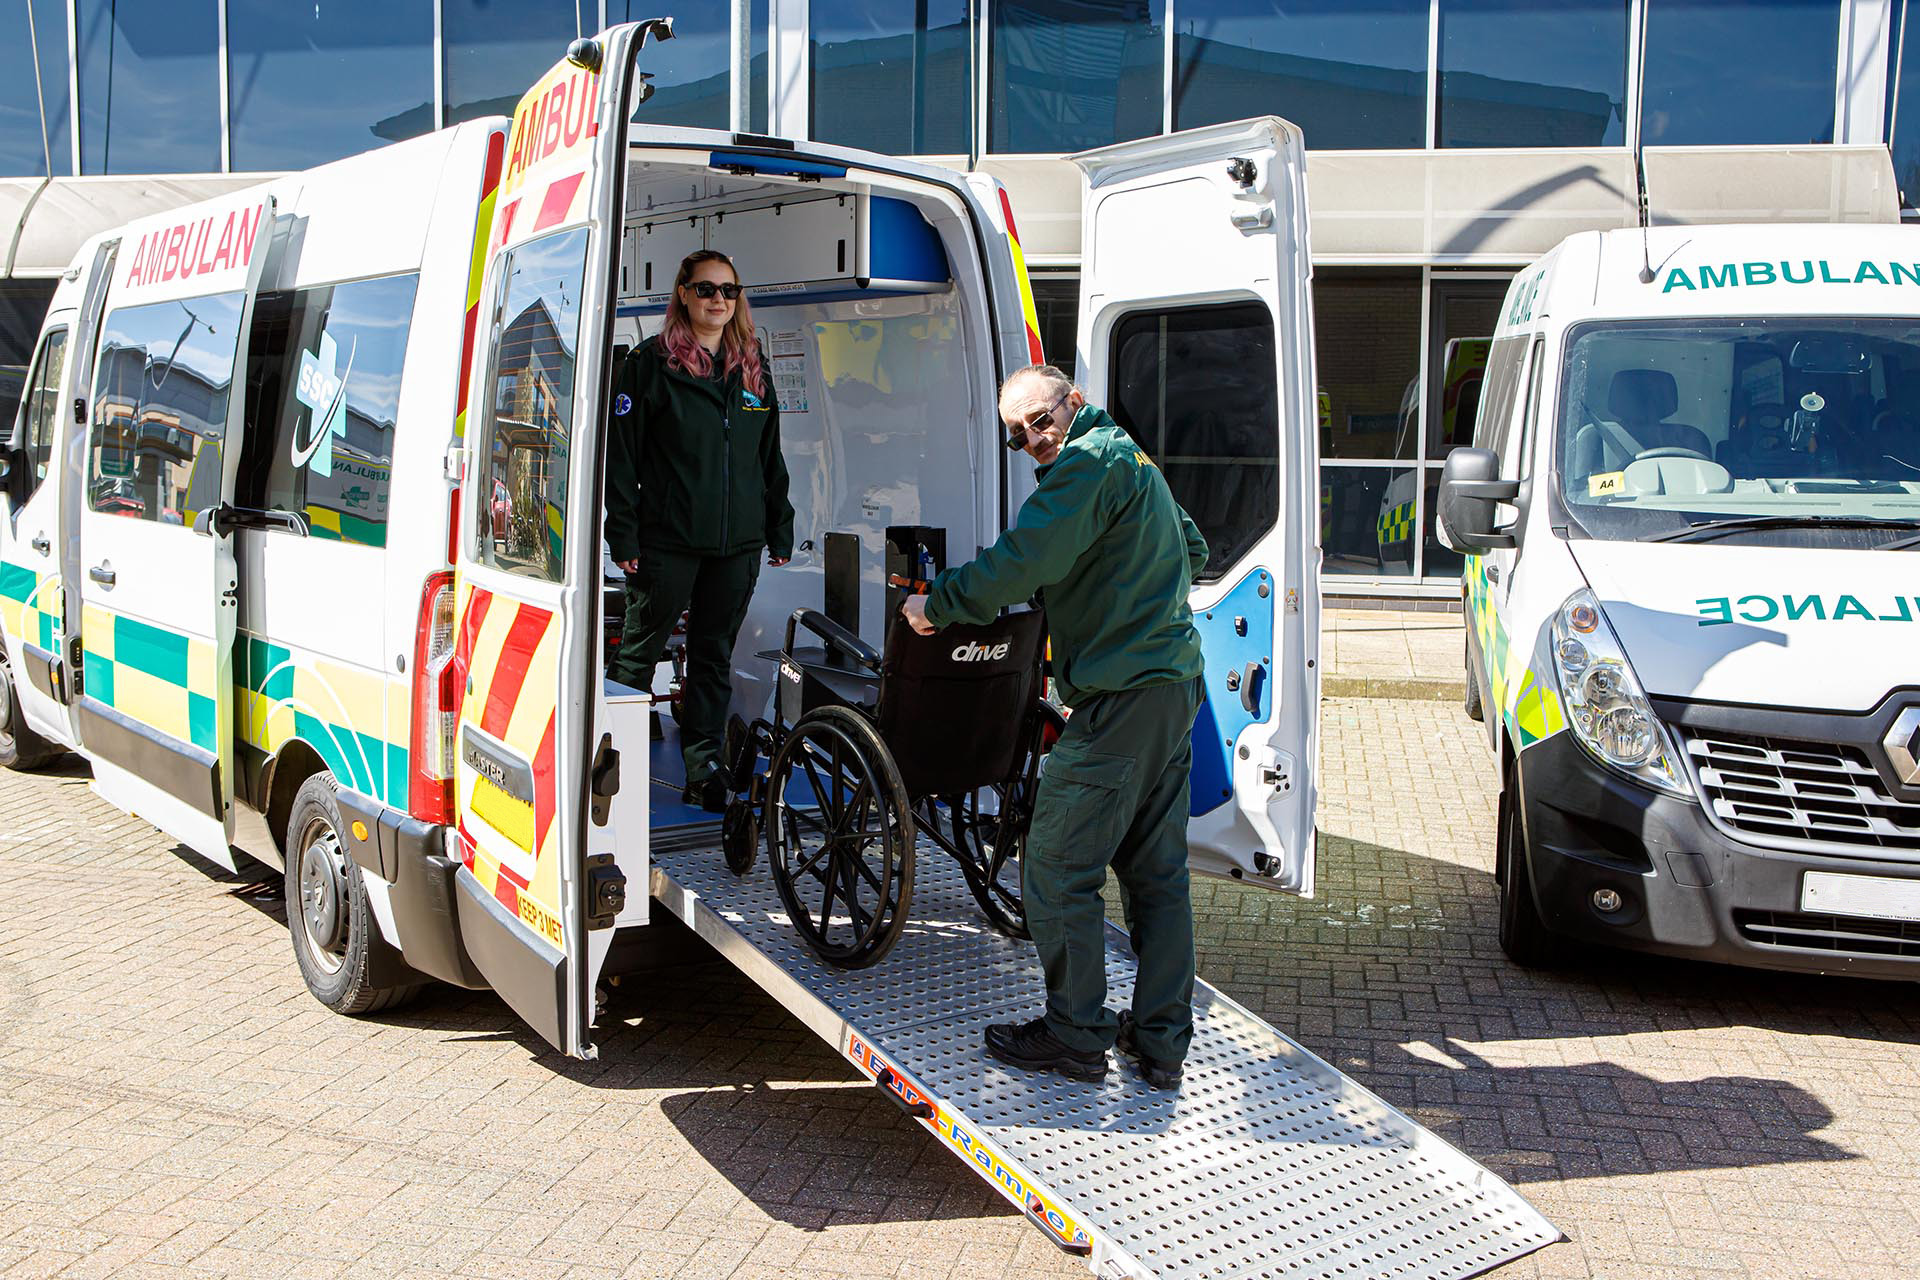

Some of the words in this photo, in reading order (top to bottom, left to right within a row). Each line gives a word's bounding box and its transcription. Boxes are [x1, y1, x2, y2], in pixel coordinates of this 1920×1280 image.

[507, 70, 599, 181] AMBUL
[126, 204, 263, 289] AMBULAN
[299, 363, 334, 410] SSC
[1600, 479, 1614, 489] AA
[951, 641, 1008, 662] drive
[781, 663, 801, 684] drive
[518, 896, 537, 927] KEEP
[538, 910, 545, 933] 3
